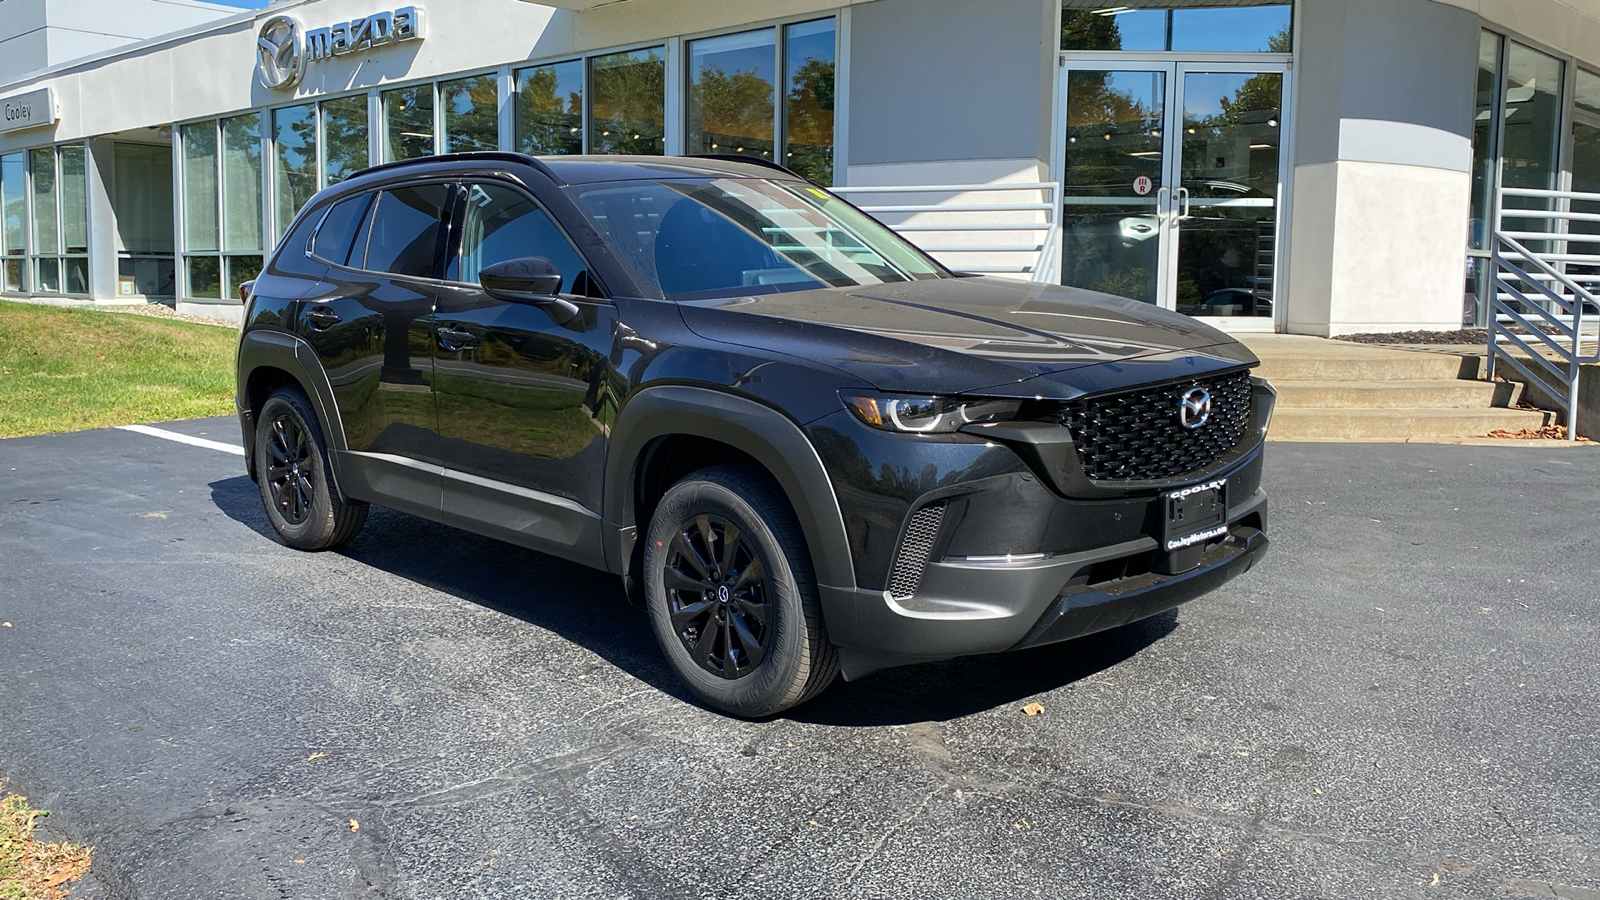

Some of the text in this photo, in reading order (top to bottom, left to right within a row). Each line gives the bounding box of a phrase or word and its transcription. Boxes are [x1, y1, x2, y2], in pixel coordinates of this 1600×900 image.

[5, 98, 31, 121] Cooley
[1139, 185, 1146, 193] R
[1170, 478, 1227, 499] COOLEY
[1167, 525, 1228, 550] CooleyMotors.com
